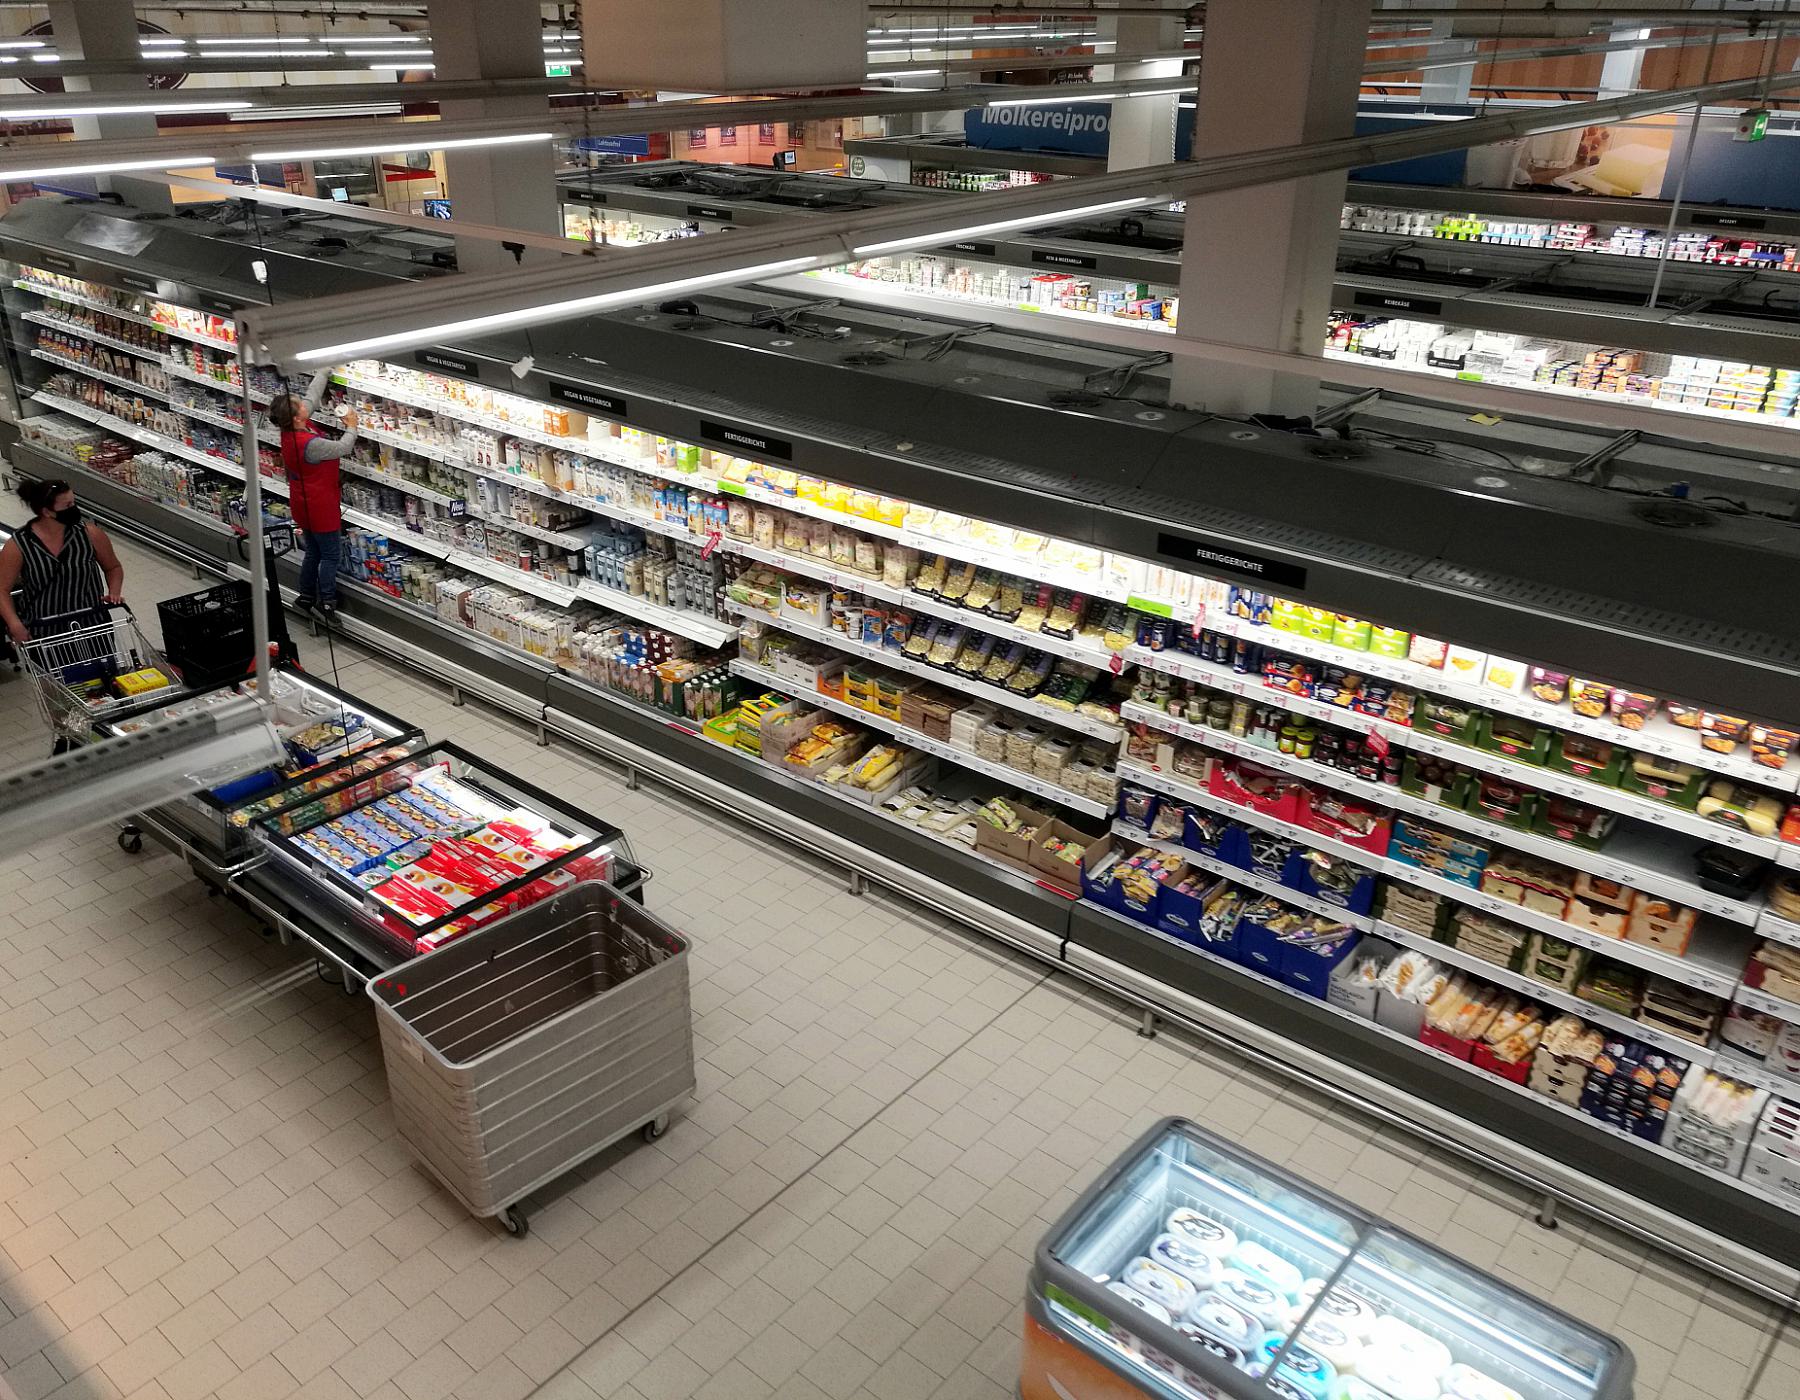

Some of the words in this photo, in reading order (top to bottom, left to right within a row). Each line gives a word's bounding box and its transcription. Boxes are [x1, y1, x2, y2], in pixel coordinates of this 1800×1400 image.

[981, 104, 1111, 136] Molkereipro
[563, 390, 579, 400] VEGAN
[583, 394, 612, 408] VEGETARISCH
[724, 431, 766, 449] FERTIGGERICHTE
[1196, 549, 1263, 573] FERTIGGERICHTE
